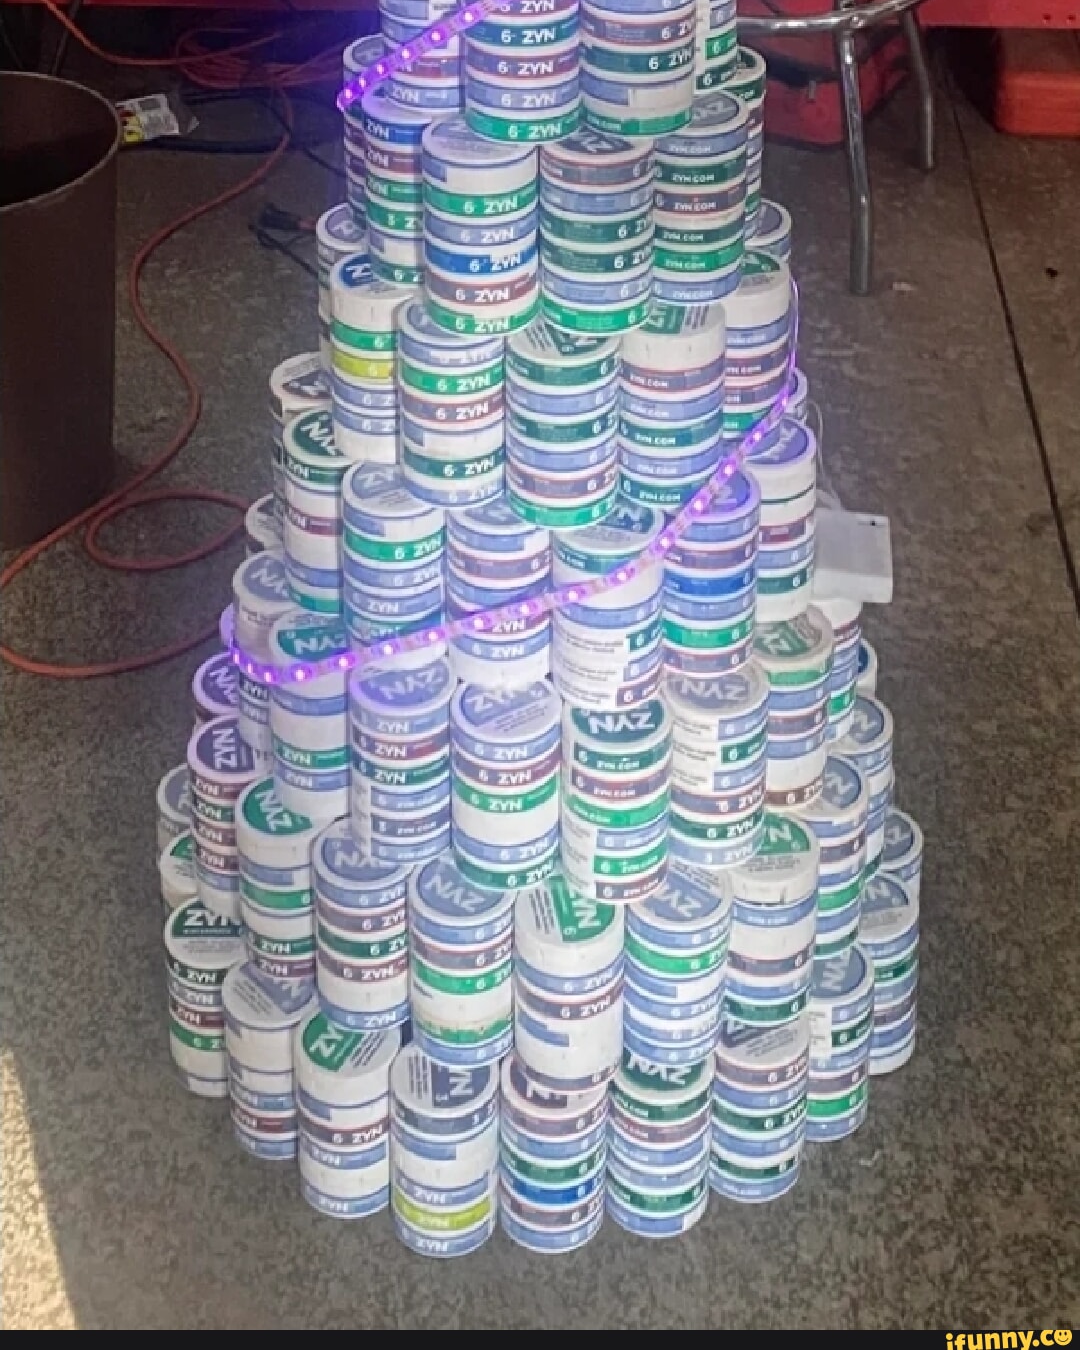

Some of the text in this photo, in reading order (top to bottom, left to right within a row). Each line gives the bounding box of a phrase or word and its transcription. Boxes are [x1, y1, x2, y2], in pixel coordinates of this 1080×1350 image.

[521, 27, 557, 44] ZYN
[517, 61, 554, 75] ZYN
[522, 92, 556, 108] ZYN
[527, 122, 562, 139] ZYN
[483, 195, 518, 213] ZYN
[474, 287, 510, 302] ZYN
[456, 374, 491, 392] ZYN
[455, 402, 489, 420] ZYN
[464, 455, 496, 475] ZYN
[376, 721, 410, 734] ZYN
[375, 742, 408, 757] ZYN
[494, 746, 528, 759] ZYN
[374, 769, 406, 785] ZYN
[498, 771, 532, 785] ZYN
[488, 799, 524, 811] ZYN
[261, 941, 291, 954] ZYN
[187, 969, 216, 984] ZYN
[580, 999, 611, 1017] ZYN
